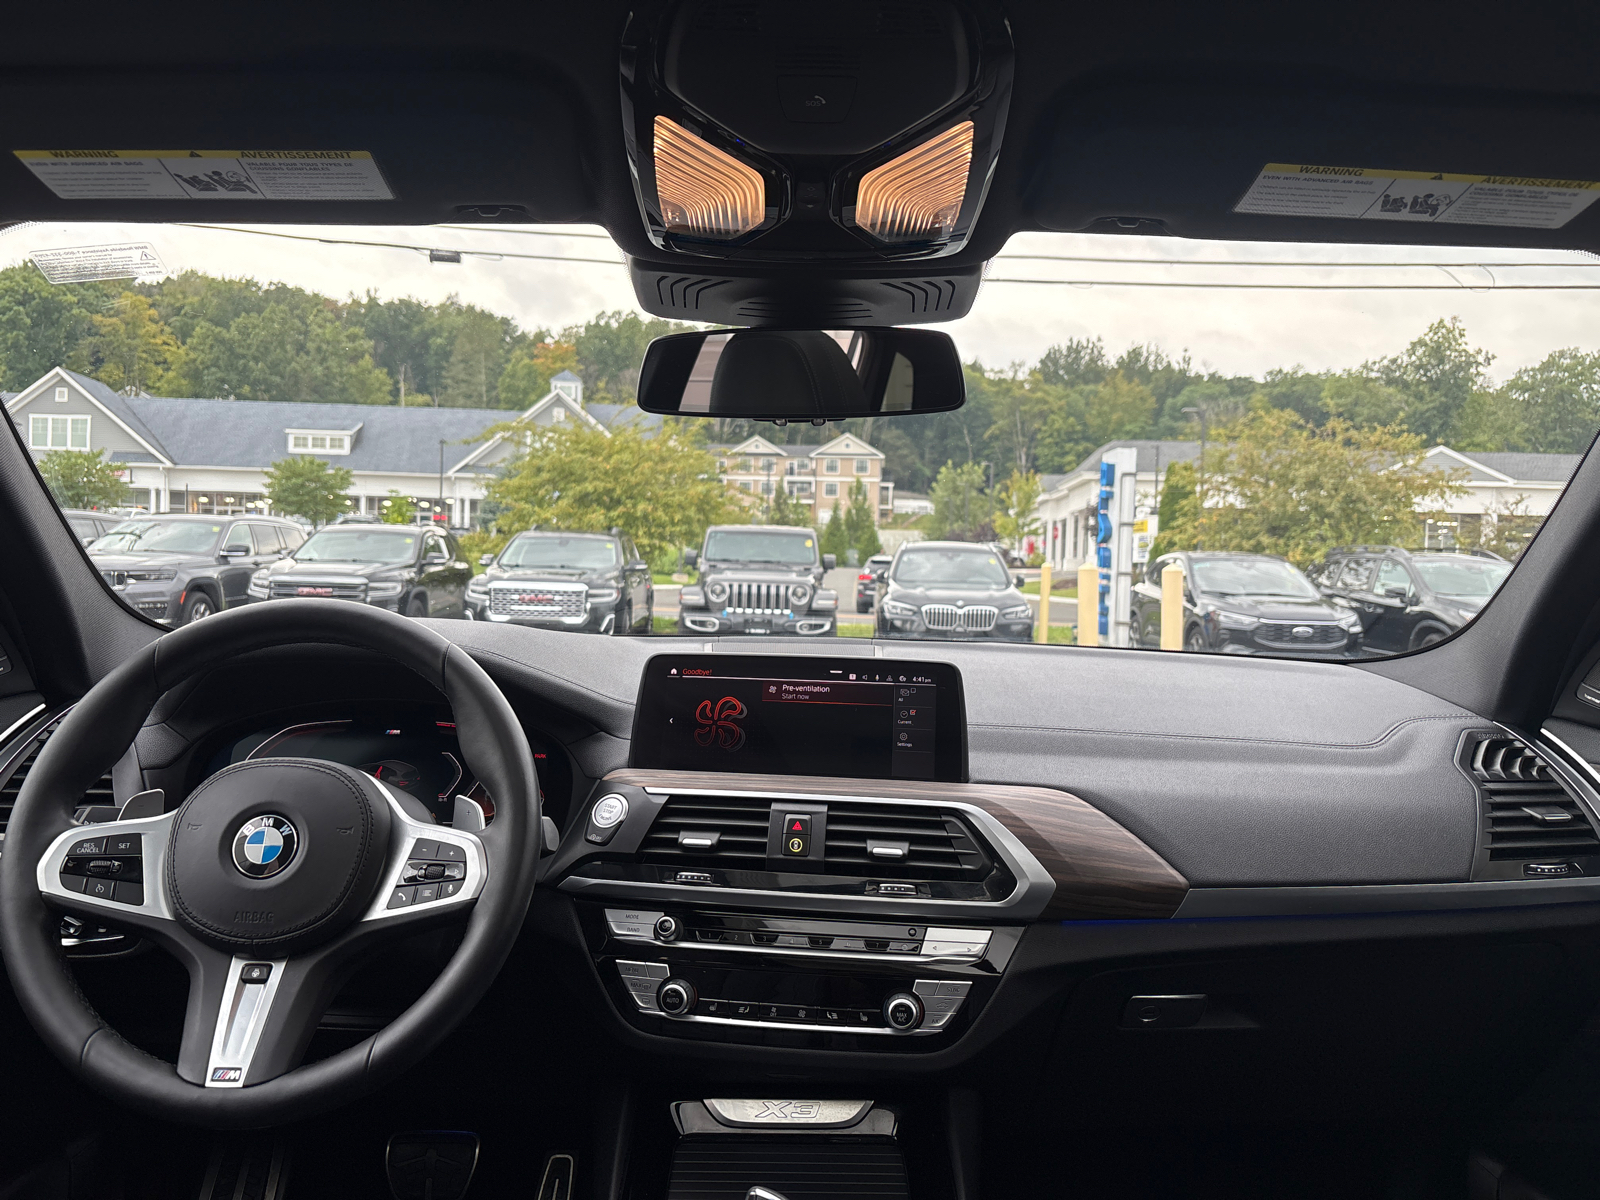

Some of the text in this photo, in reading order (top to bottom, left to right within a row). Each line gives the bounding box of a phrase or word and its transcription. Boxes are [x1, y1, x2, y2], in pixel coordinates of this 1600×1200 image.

[50, 150, 119, 159] WARNING
[240, 151, 352, 159] AVERTISSEMENT
[1299, 165, 1365, 177] WARNING
[1480, 176, 1592, 189] AVERTISSEMENT
[297, 587, 333, 596] GMC
[519, 594, 554, 603] GMC
[682, 667, 713, 677] Goodbye!
[782, 684, 830, 694] Pre-ventilation
[781, 692, 795, 700] Start
[604, 802, 618, 810] START
[242, 817, 293, 837] BMW
[233, 911, 275, 924] AIRBAG
[666, 996, 680, 1004] AUTO
[755, 1100, 821, 1119] X3
